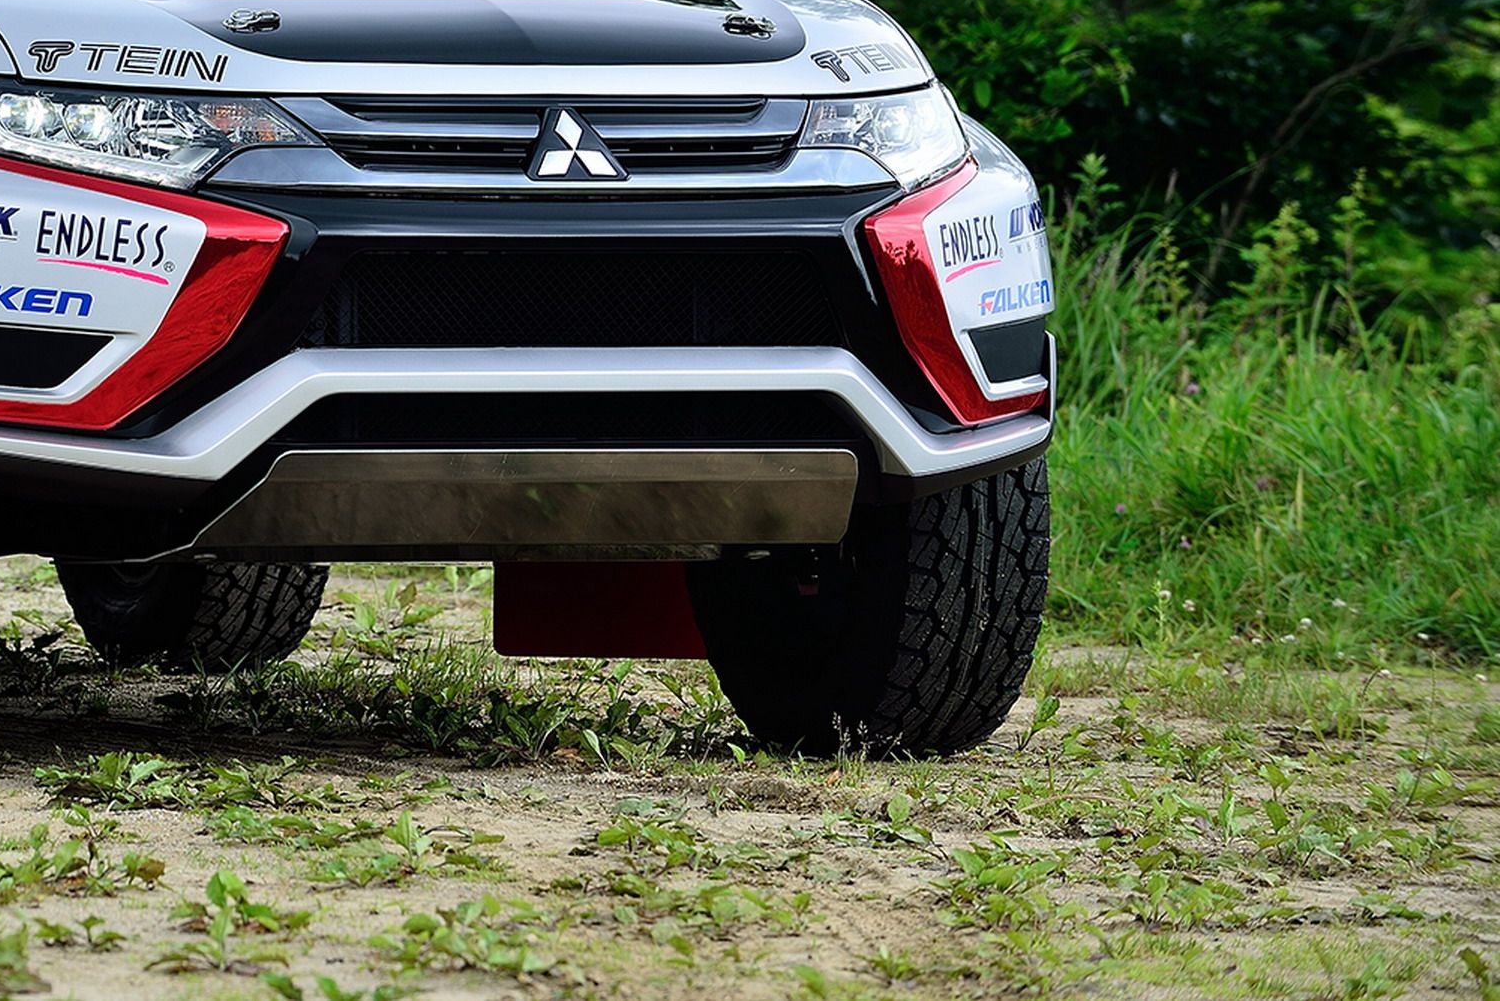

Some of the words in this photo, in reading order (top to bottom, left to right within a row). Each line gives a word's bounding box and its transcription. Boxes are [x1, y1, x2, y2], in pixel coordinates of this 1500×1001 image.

[80, 44, 228, 82] TEIN
[36, 210, 170, 268] ENDLESS
[940, 214, 999, 267] ENDLESS
[978, 279, 1051, 316] FALKEN
